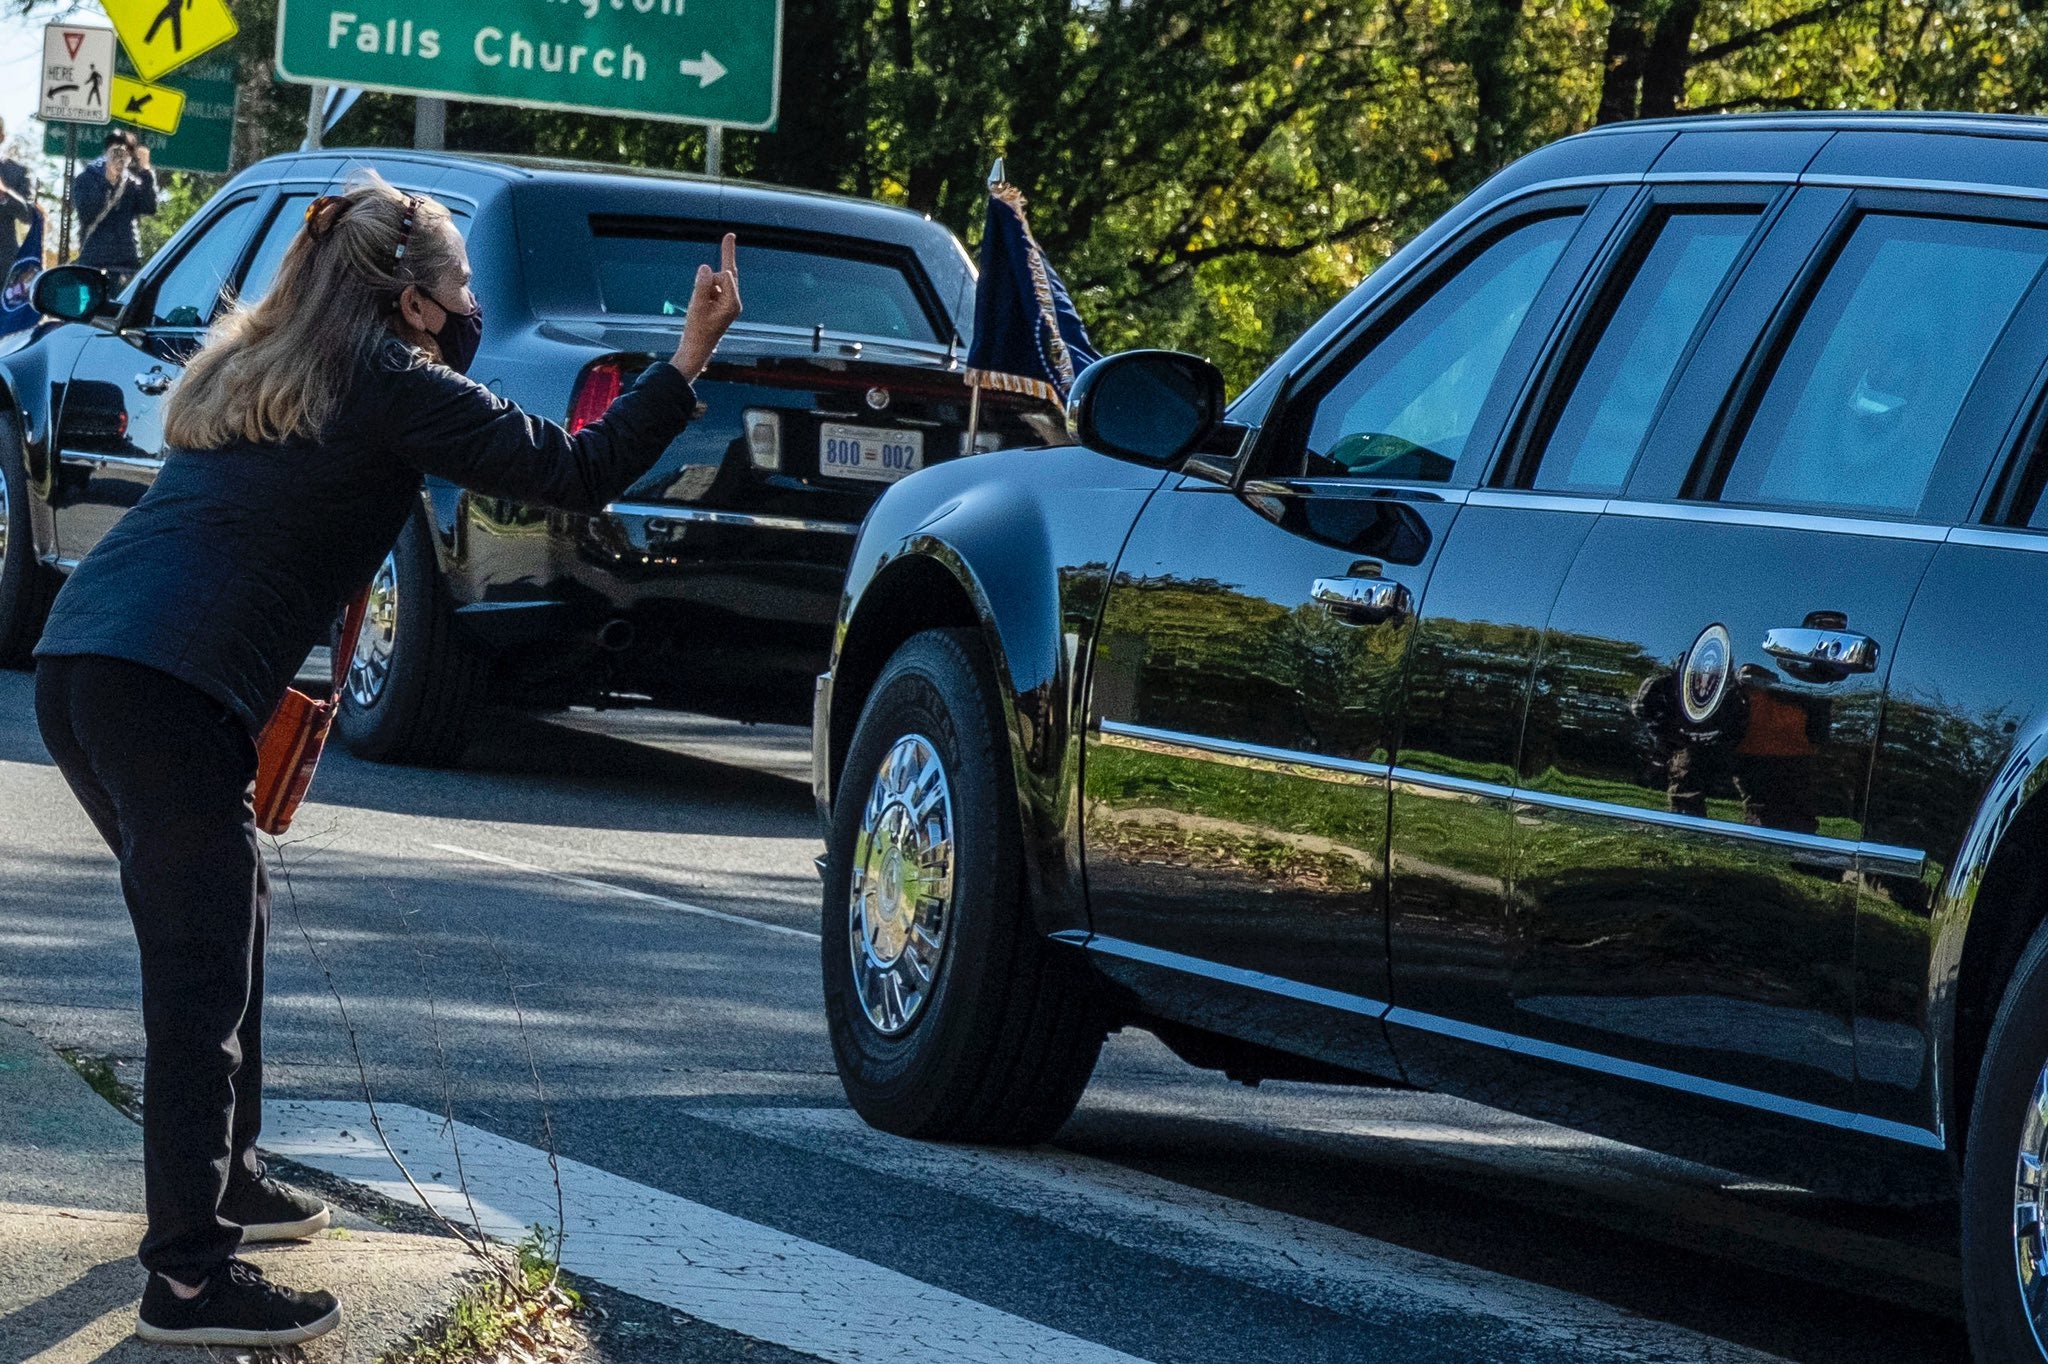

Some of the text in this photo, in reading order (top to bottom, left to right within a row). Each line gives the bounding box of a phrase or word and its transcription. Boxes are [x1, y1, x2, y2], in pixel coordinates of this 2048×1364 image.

[328, 12, 648, 82] Falls Church
[48, 66, 73, 81] HERE
[827, 438, 915, 471] 800 002
